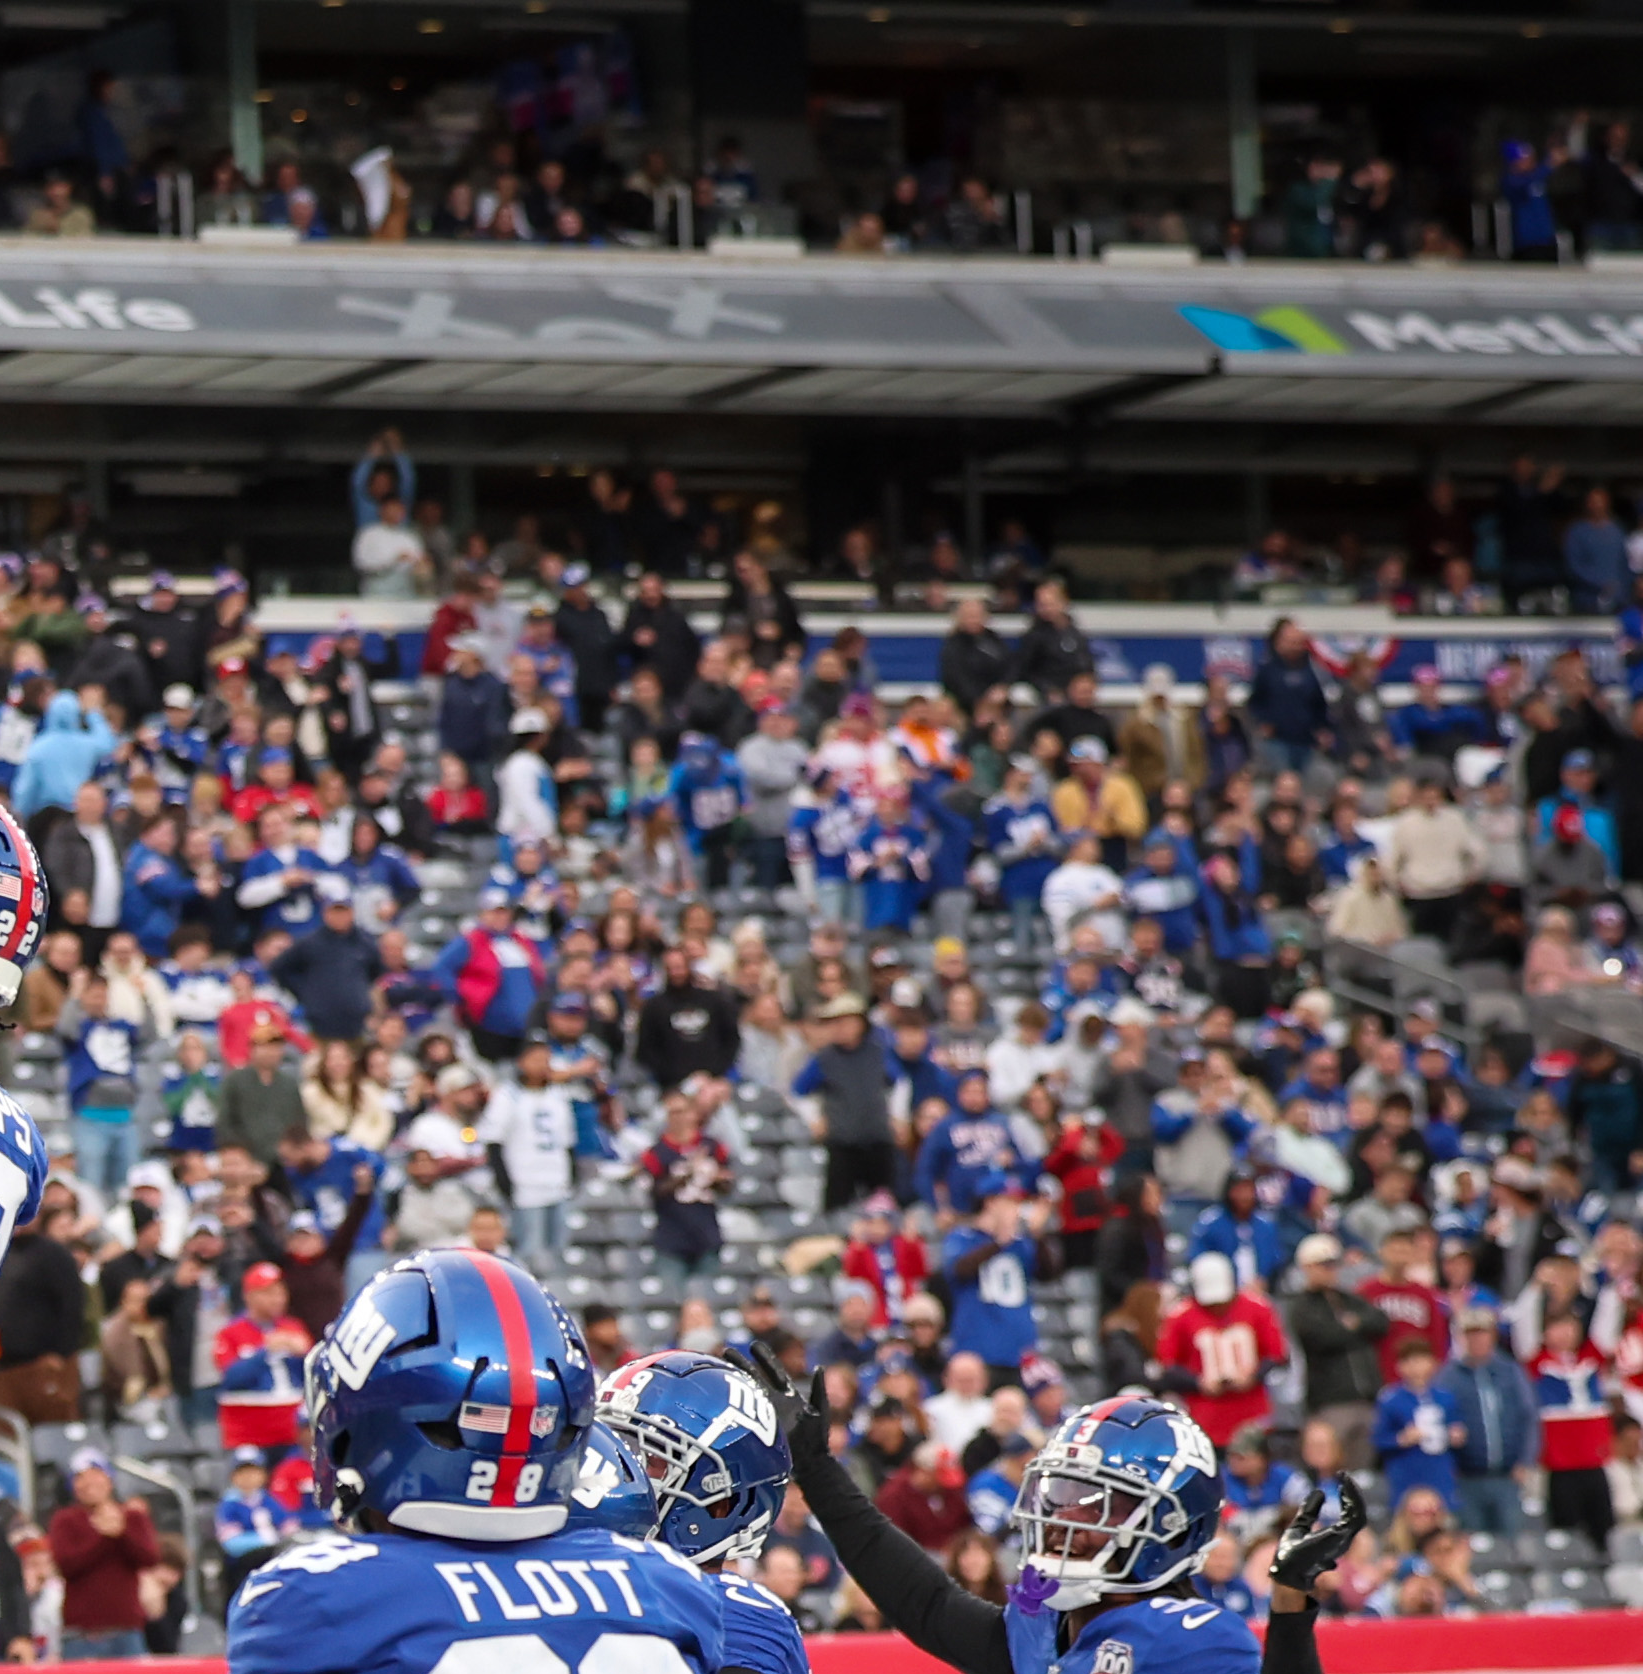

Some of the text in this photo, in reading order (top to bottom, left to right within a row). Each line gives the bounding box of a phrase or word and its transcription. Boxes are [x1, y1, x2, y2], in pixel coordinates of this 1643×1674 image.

[1193, 1322, 1260, 1395] 10
[466, 1459, 543, 1503] 28
[434, 1556, 646, 1623] FLOTT
